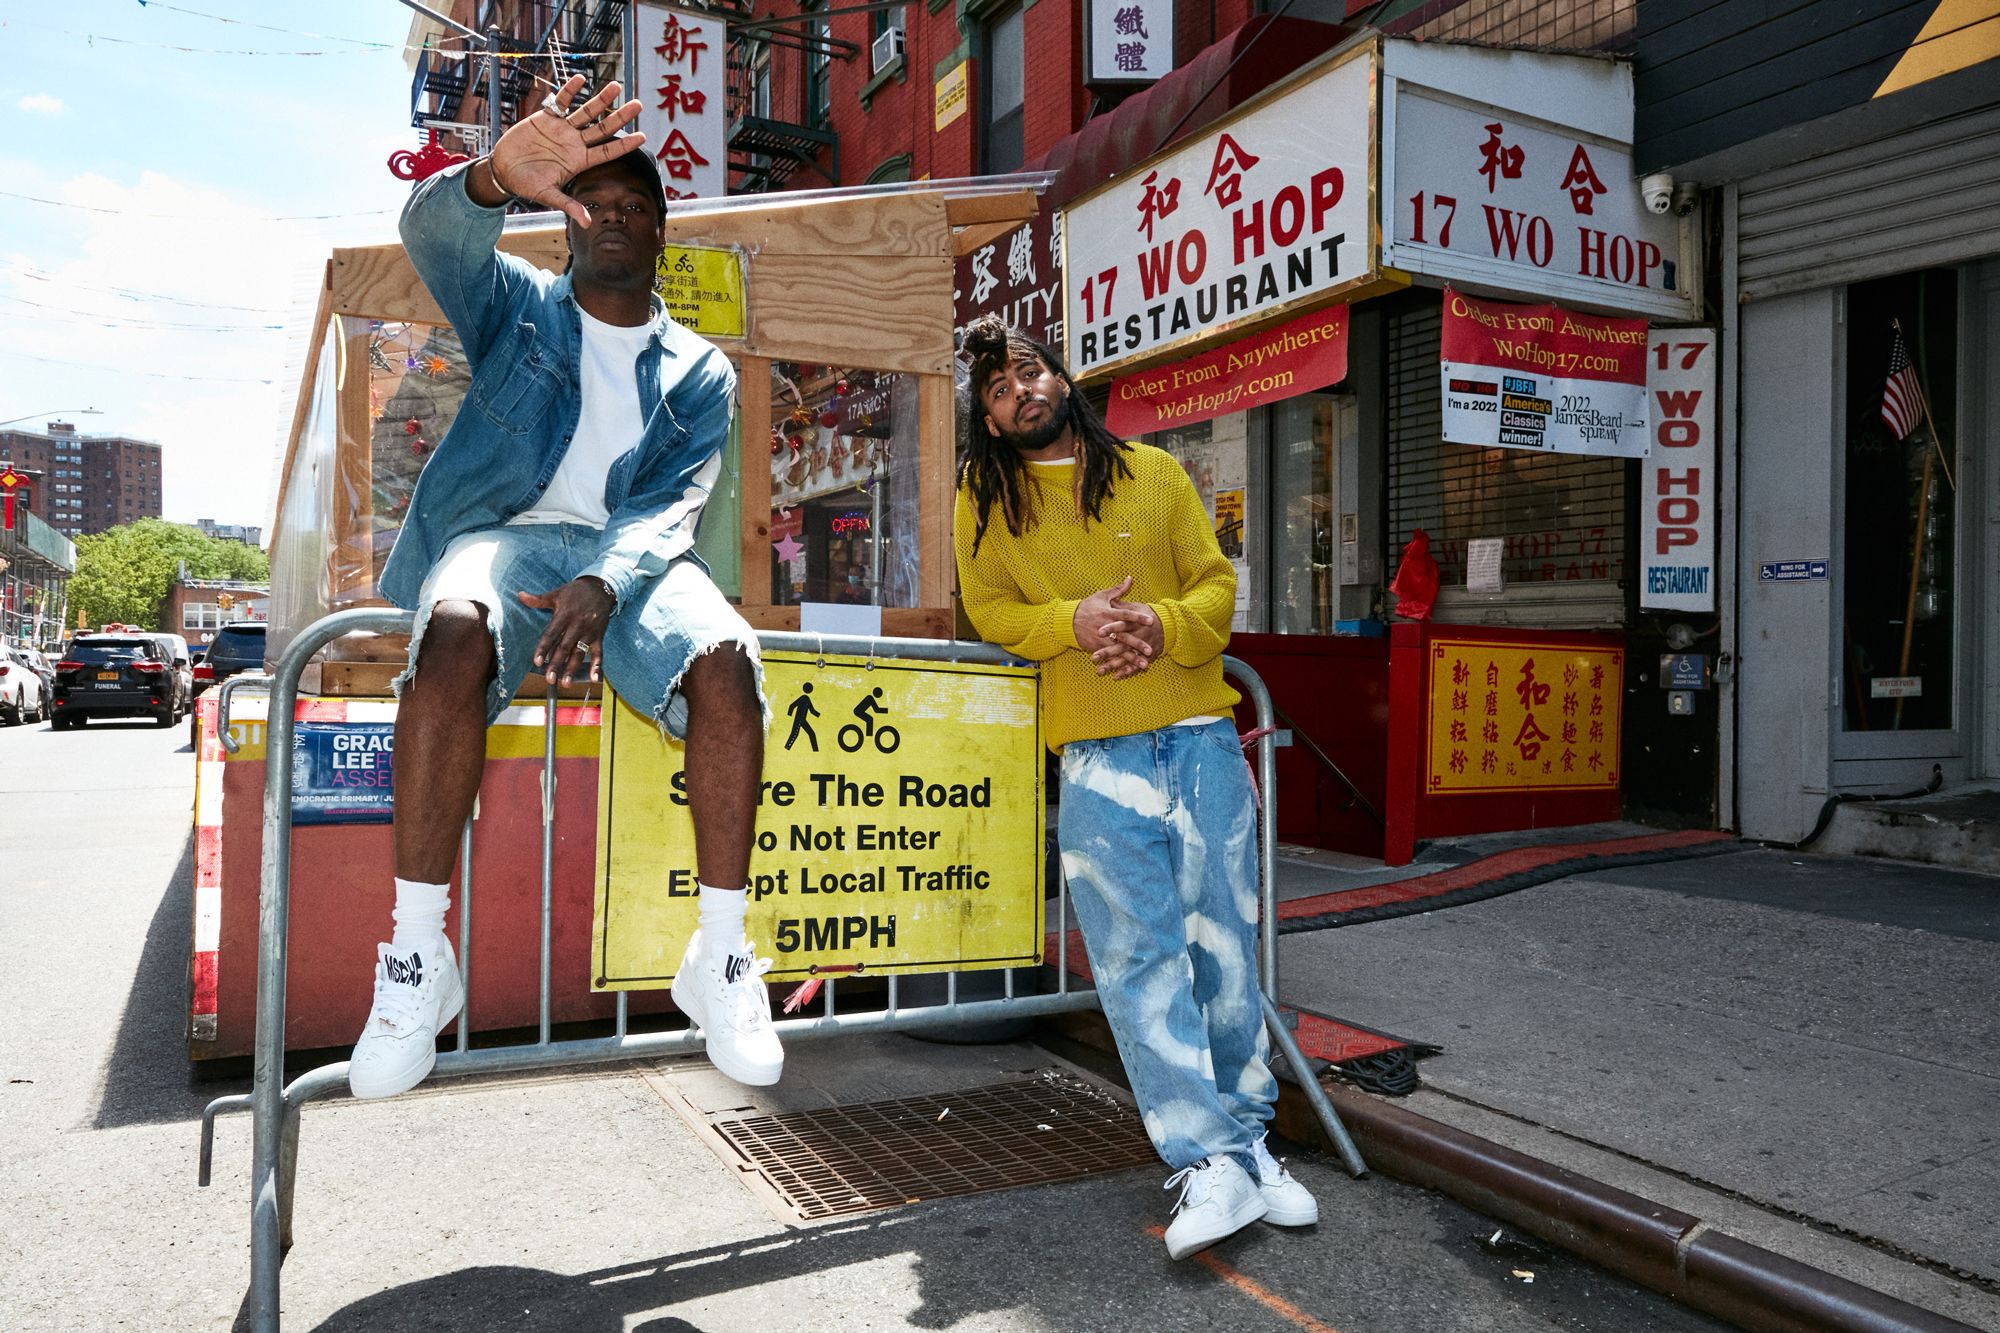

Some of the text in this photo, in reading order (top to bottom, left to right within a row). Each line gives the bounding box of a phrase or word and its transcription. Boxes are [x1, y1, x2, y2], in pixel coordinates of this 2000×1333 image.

[654, 13, 709, 201] 新和合
[1478, 122, 1607, 216] 和合
[1137, 133, 1260, 243] 和合
[1081, 167, 1344, 324] 17 WO HOP
[1409, 190, 1661, 288] 17 WO HOP
[1081, 233, 1345, 366] RESTAURANT
[1451, 297, 1500, 328] Order
[1503, 313, 1554, 333] From
[670, 316, 698, 328] MPH
[1120, 321, 1340, 401] Order From Anywhere:
[1492, 338, 1620, 373] WoHop17.com
[1652, 342, 1709, 370] 17
[1156, 370, 1294, 421] WoHop17.com
[1505, 377, 1534, 394] #JBFA
[1463, 401, 1469, 410] a
[1471, 400, 1497, 412] 2022
[1503, 412, 1544, 429] Classics
[1504, 395, 1551, 413] America's
[1560, 395, 1590, 413] 2022
[1656, 390, 1703, 448] WO
[1501, 429, 1541, 446] winner!
[1656, 468, 1700, 555] HOP
[1648, 566, 1710, 594] RESTAURANT
[1513, 657, 1551, 762] 和合
[333, 734, 394, 751] GRAC
[331, 770, 393, 787] ASSE
[669, 771, 990, 808] Sre The Road
[750, 824, 940, 851] o Not Enter
[668, 865, 990, 901] Ept Local Traffic
[775, 914, 896, 953] 5MPH
